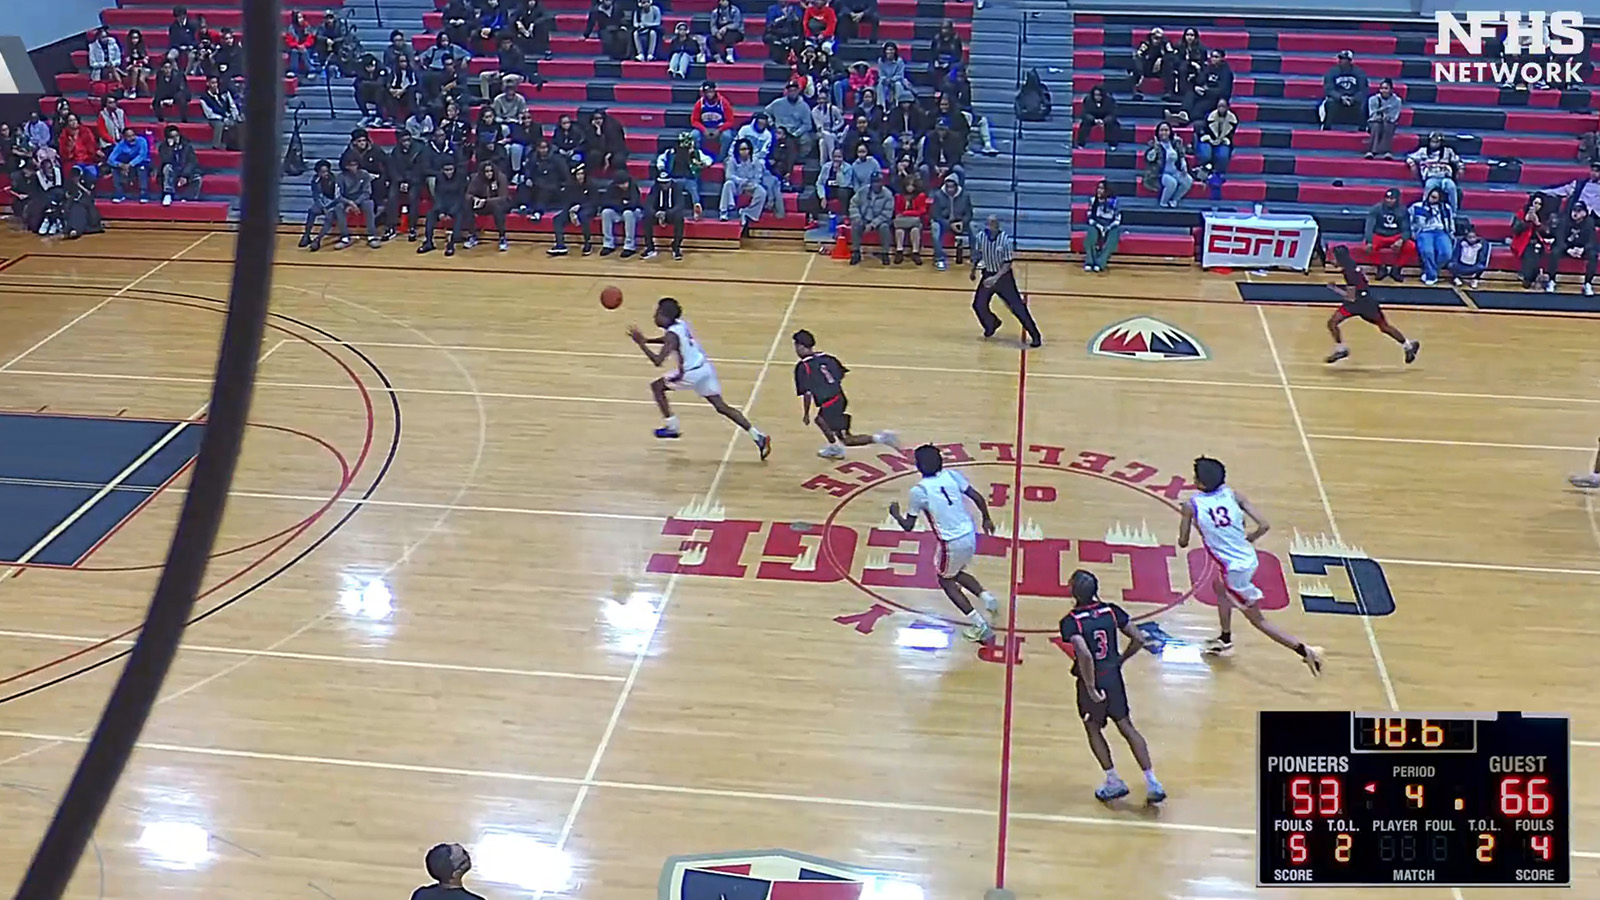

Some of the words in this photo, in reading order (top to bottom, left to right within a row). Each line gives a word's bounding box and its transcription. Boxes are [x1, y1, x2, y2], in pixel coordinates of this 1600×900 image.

[1208, 224, 1300, 258] ESPN
[801, 442, 1200, 500] XCELLENCE
[940, 486, 953, 506] 1
[987, 483, 1056, 507] OF
[1208, 506, 1232, 528] 13
[1093, 630, 1108, 660] 3
